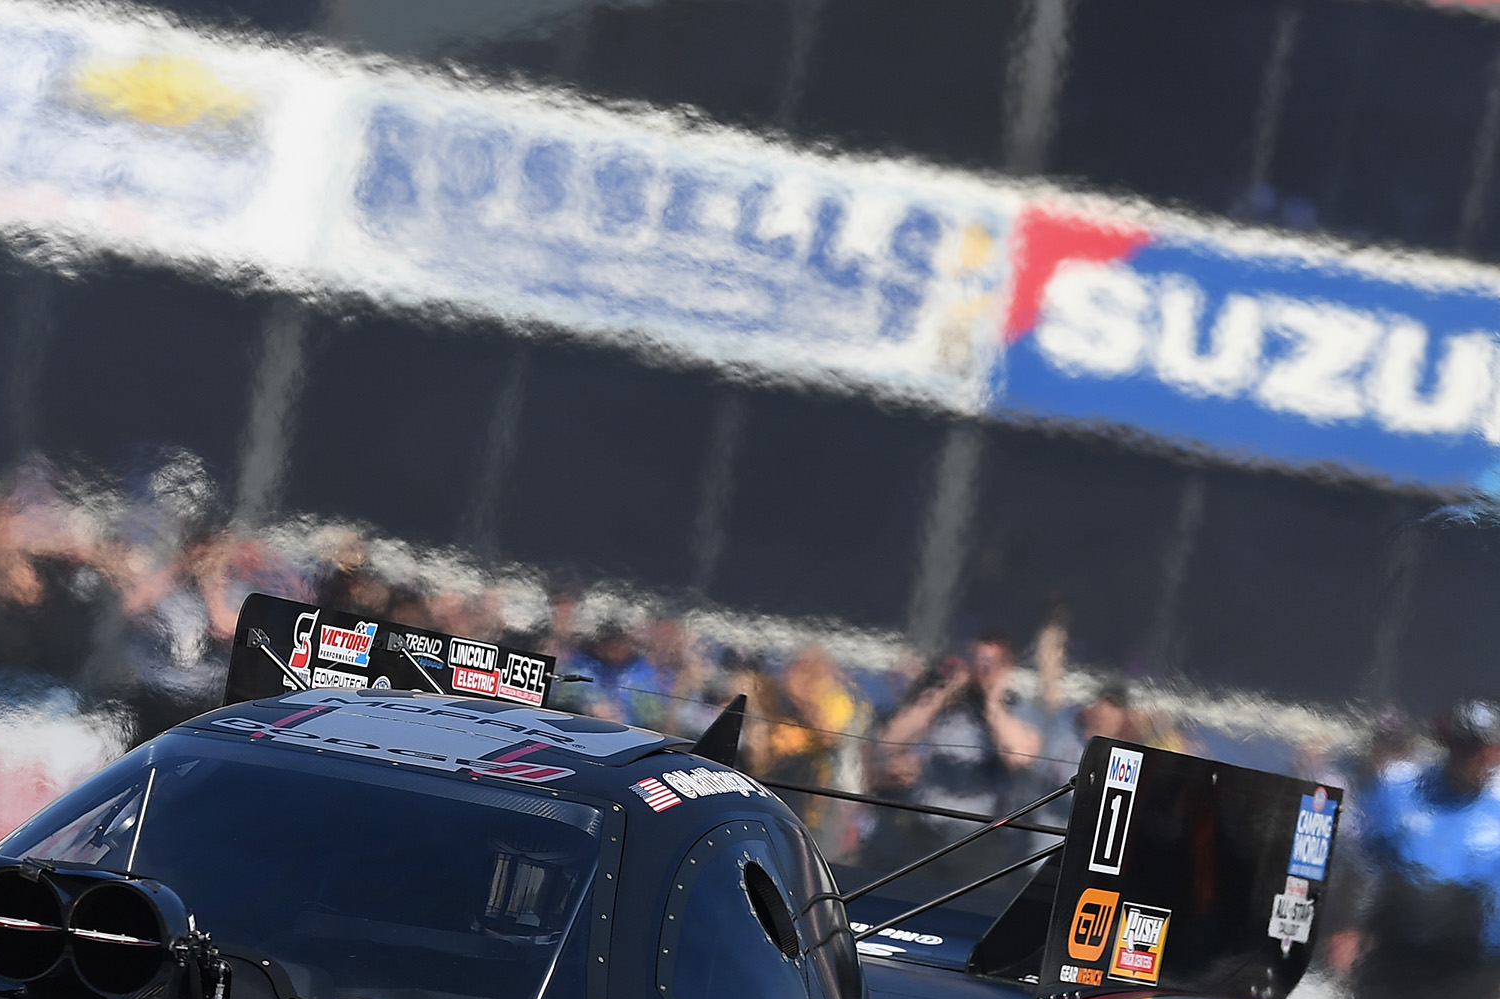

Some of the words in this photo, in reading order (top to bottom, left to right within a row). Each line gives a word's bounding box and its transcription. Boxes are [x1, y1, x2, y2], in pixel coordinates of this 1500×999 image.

[1034, 259, 1500, 442] SUZU
[322, 627, 371, 653] VICTORY
[405, 633, 443, 656] TREND
[320, 650, 355, 663] PERFORMANCE
[450, 643, 496, 671] LINCOLN
[314, 671, 367, 688] COMPUTECH
[457, 670, 496, 692] ELECTRIC
[500, 656, 546, 694] JESEL
[1109, 756, 1140, 784] Mobil
[1104, 795, 1122, 859] 1
[1121, 907, 1165, 952] RUSH
